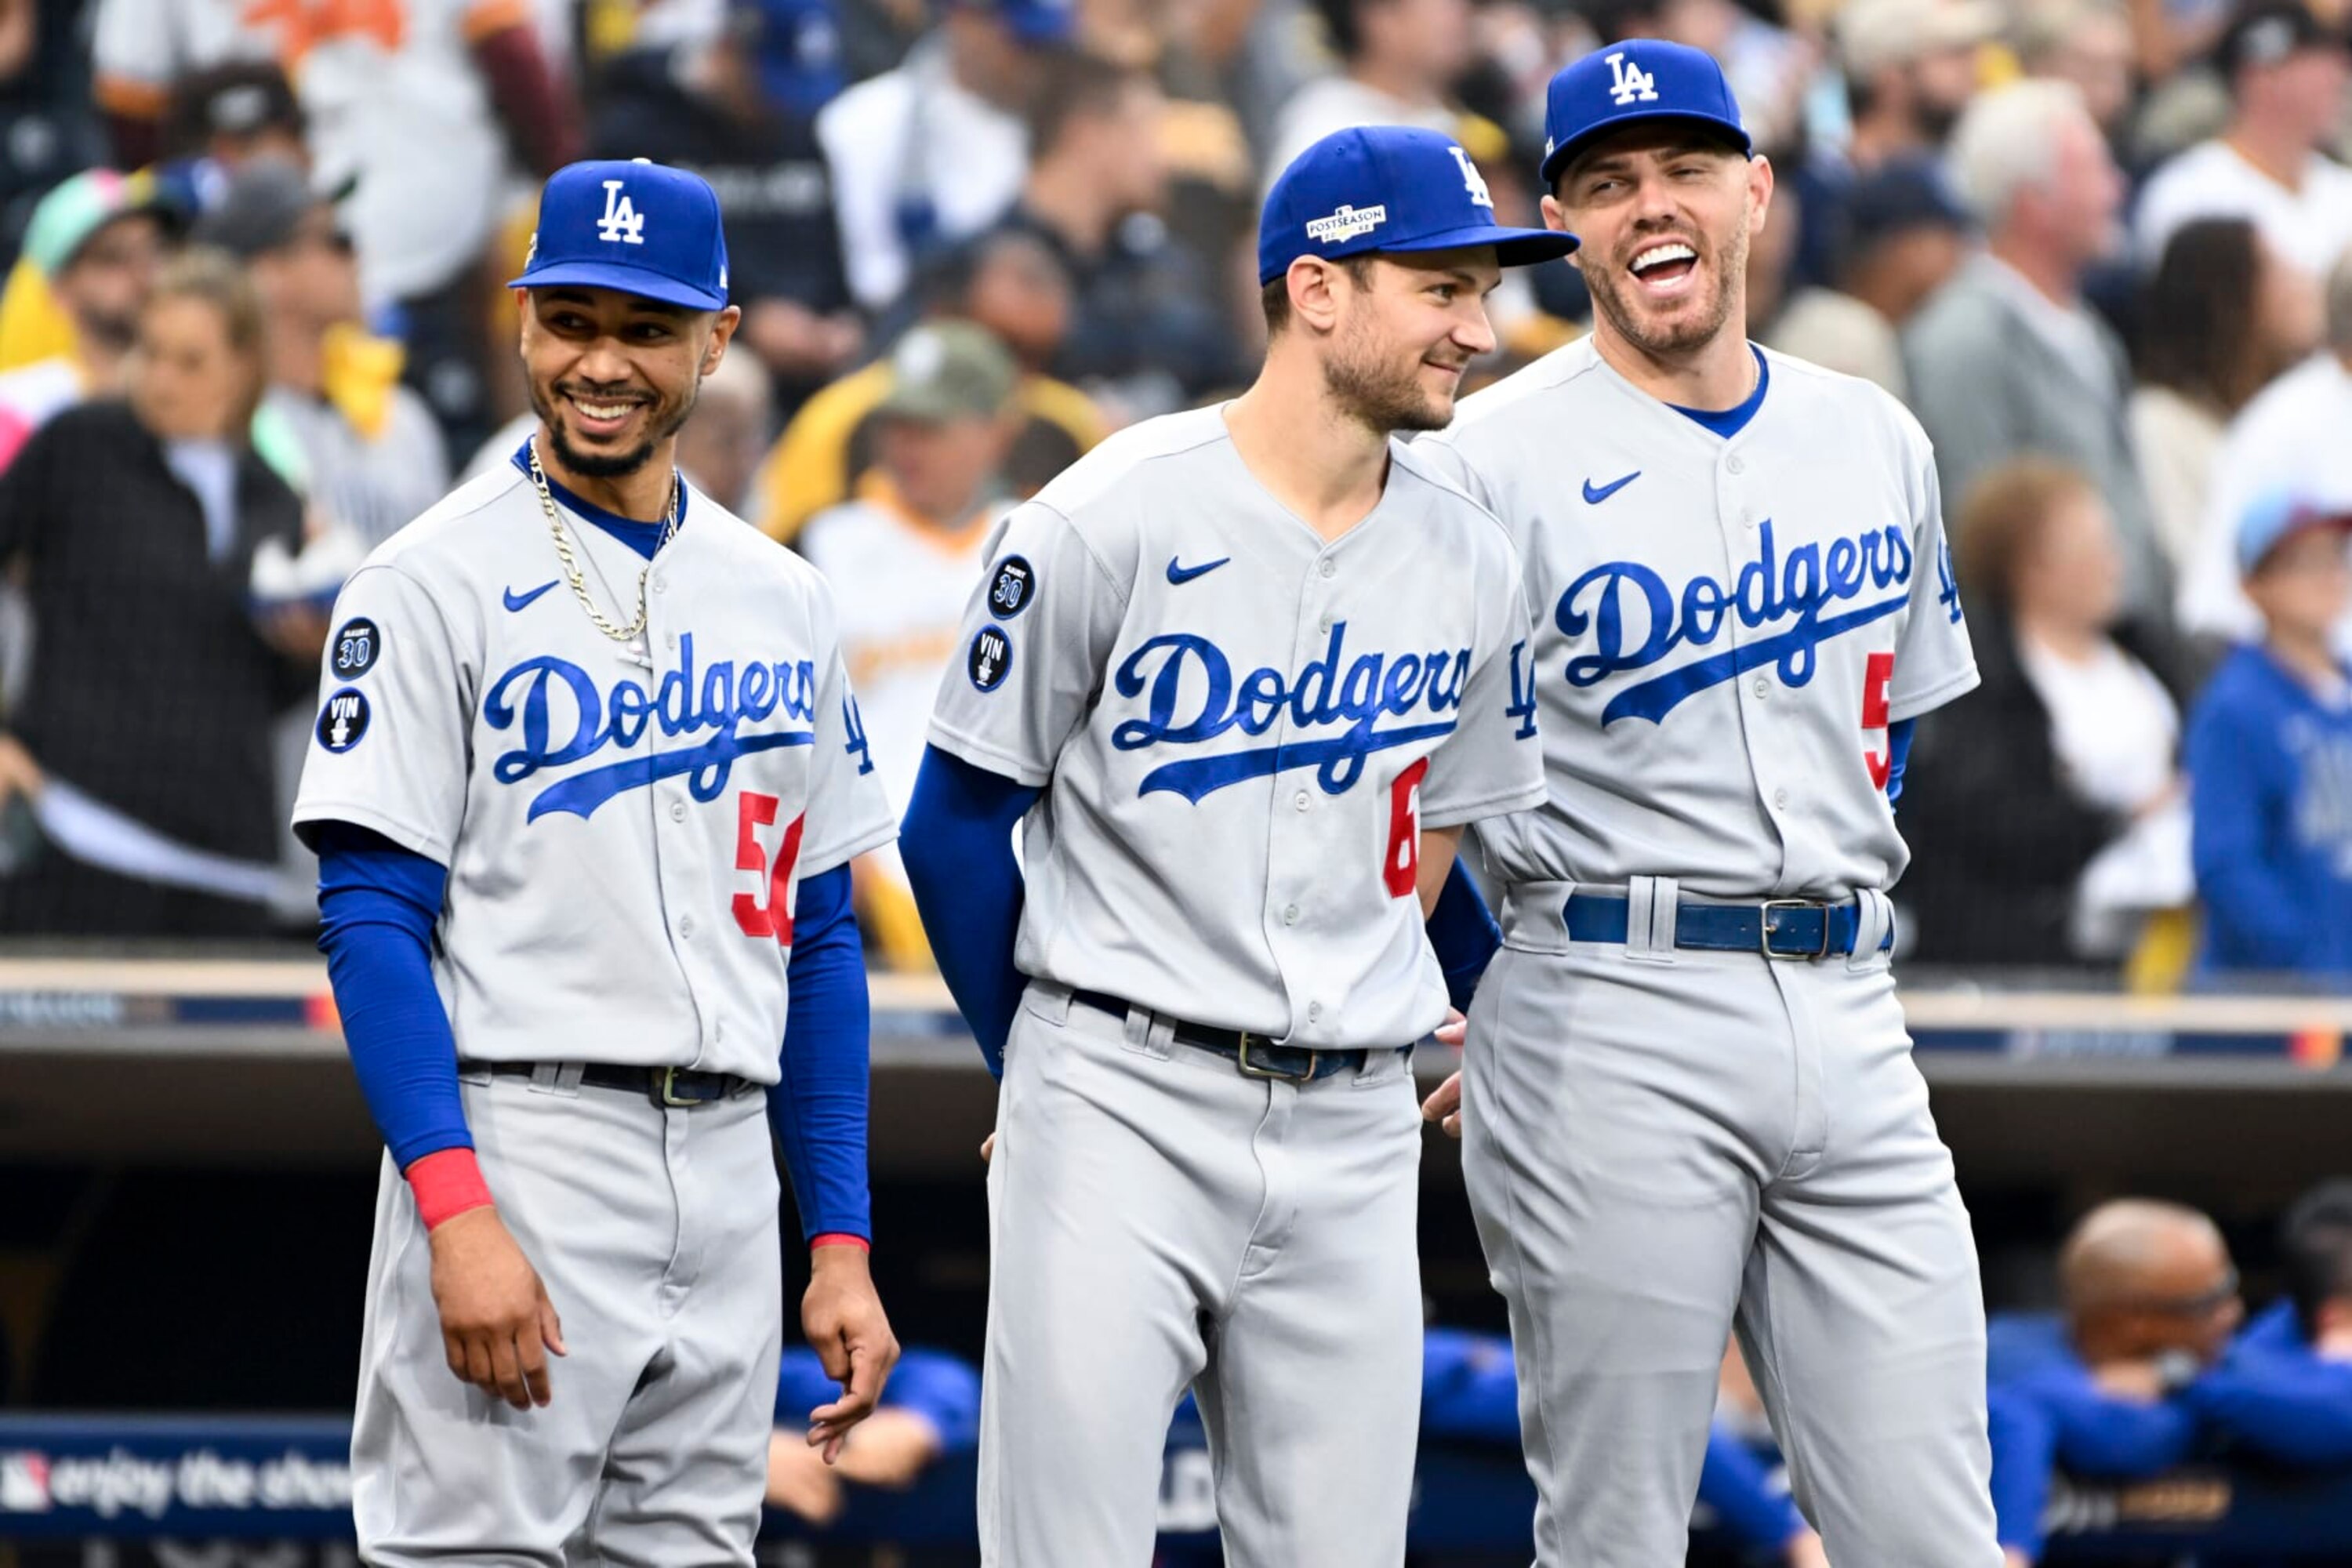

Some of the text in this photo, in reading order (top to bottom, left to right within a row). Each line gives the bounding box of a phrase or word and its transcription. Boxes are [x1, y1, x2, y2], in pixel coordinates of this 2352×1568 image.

[1605, 53, 1659, 106] LA
[1447, 146, 1494, 210] LA
[597, 180, 644, 245] LA
[1309, 209, 1382, 234] POSTSEASON
[994, 573, 1023, 609] 30
[981, 633, 1004, 661] VIN
[1555, 517, 1911, 729] Dodgers
[338, 637, 371, 669] 30
[331, 696, 359, 720] VIN
[484, 631, 815, 826] Dodgers
[1861, 652, 1896, 791] 5
[1383, 755, 1429, 899] 6
